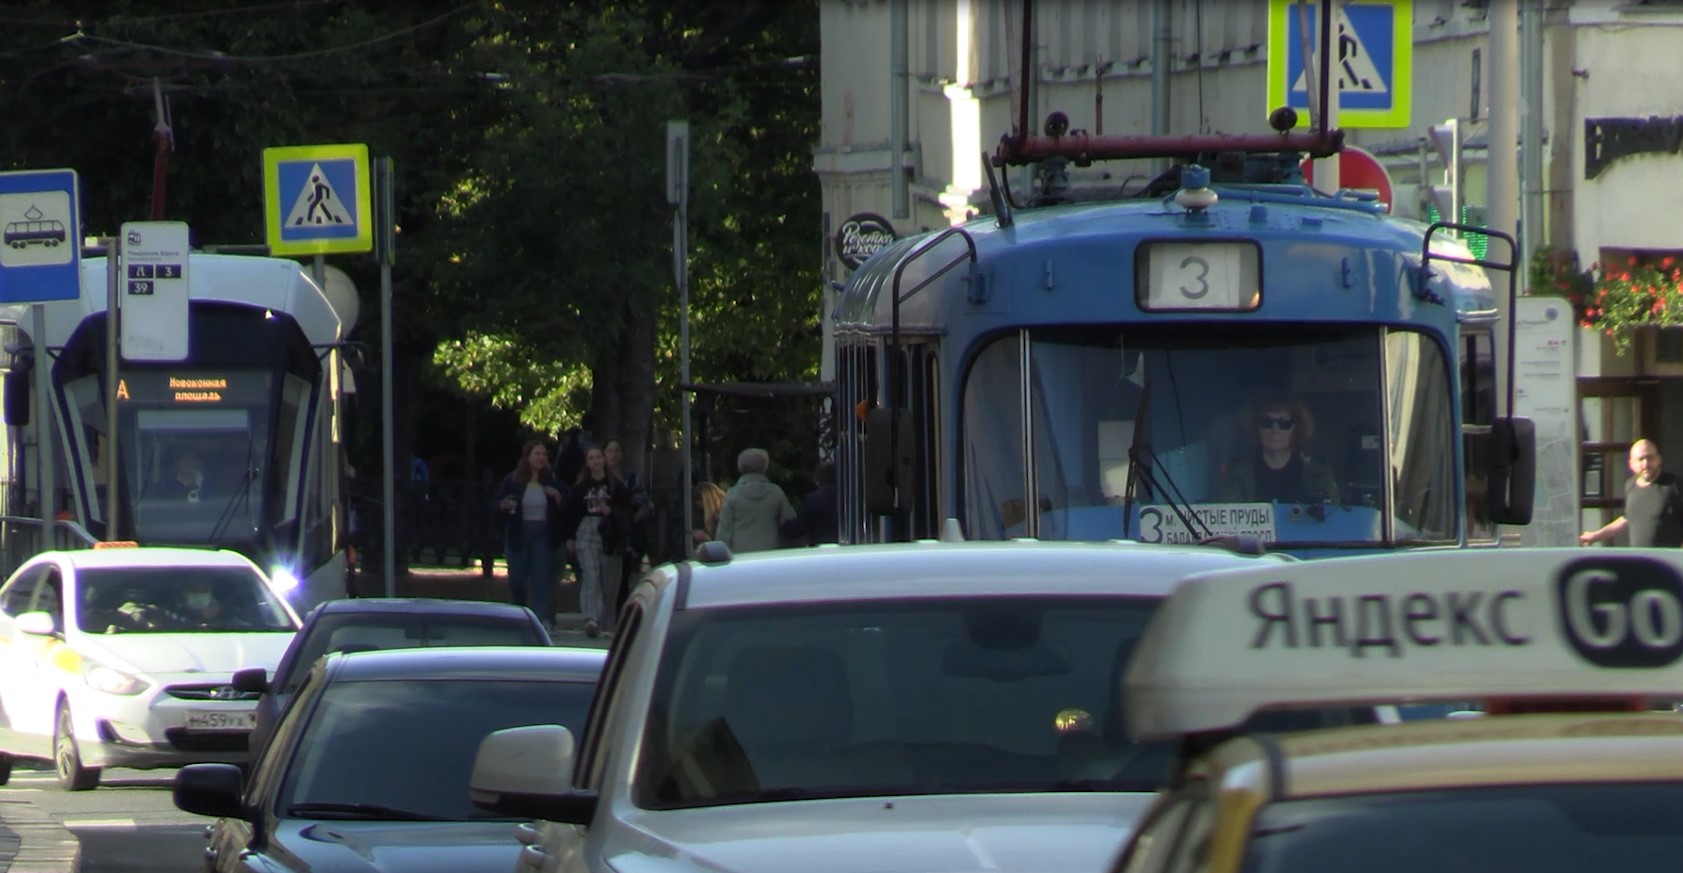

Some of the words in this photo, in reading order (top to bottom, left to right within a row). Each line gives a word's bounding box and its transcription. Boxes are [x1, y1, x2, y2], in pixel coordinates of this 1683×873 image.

[134, 282, 149, 294] 39
[164, 266, 173, 277] 3
[1180, 256, 1209, 300] 3
[1139, 506, 1163, 544] 3
[1178, 509, 1227, 525] ИСТЫЕ
[1230, 508, 1270, 527] ПРУДЫ
[1248, 582, 1531, 658] Яндекс
[1564, 567, 1682, 647] Go
